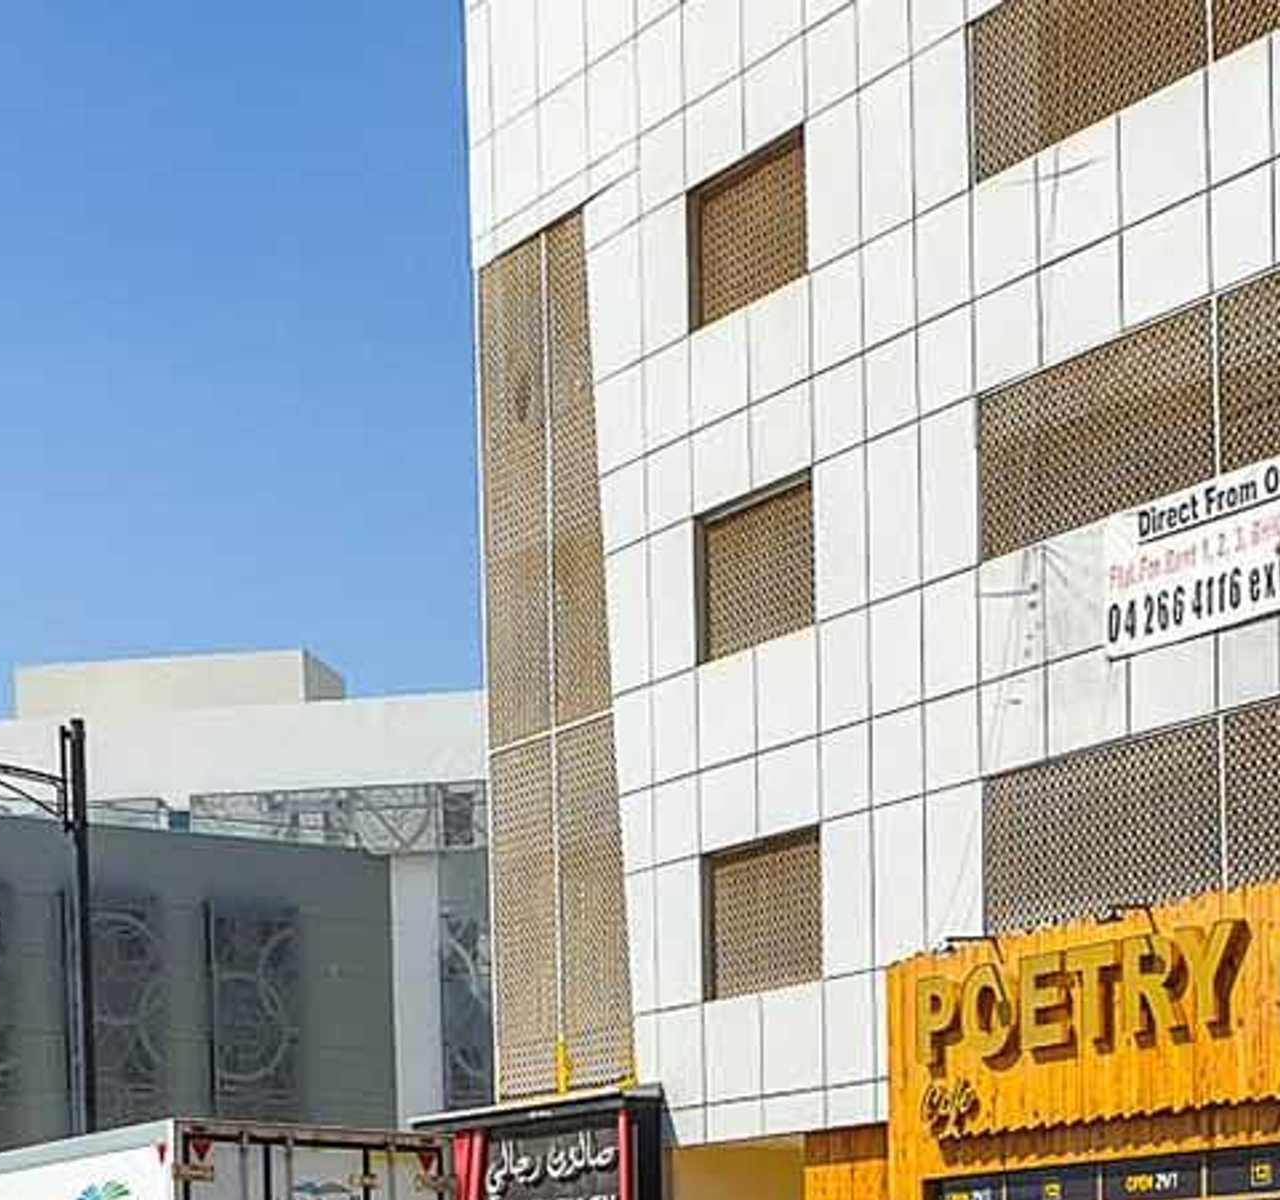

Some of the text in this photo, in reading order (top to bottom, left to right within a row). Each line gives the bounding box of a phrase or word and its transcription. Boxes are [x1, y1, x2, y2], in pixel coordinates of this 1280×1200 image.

[1137, 496, 1199, 538] Direct
[1205, 485, 1257, 516] From
[1108, 600, 1136, 643] 04
[1144, 586, 1184, 635] 266
[1193, 567, 1241, 619] 4116
[915, 918, 1250, 1070] POETRY
[486, 1129, 618, 1200] صالون رجالي
